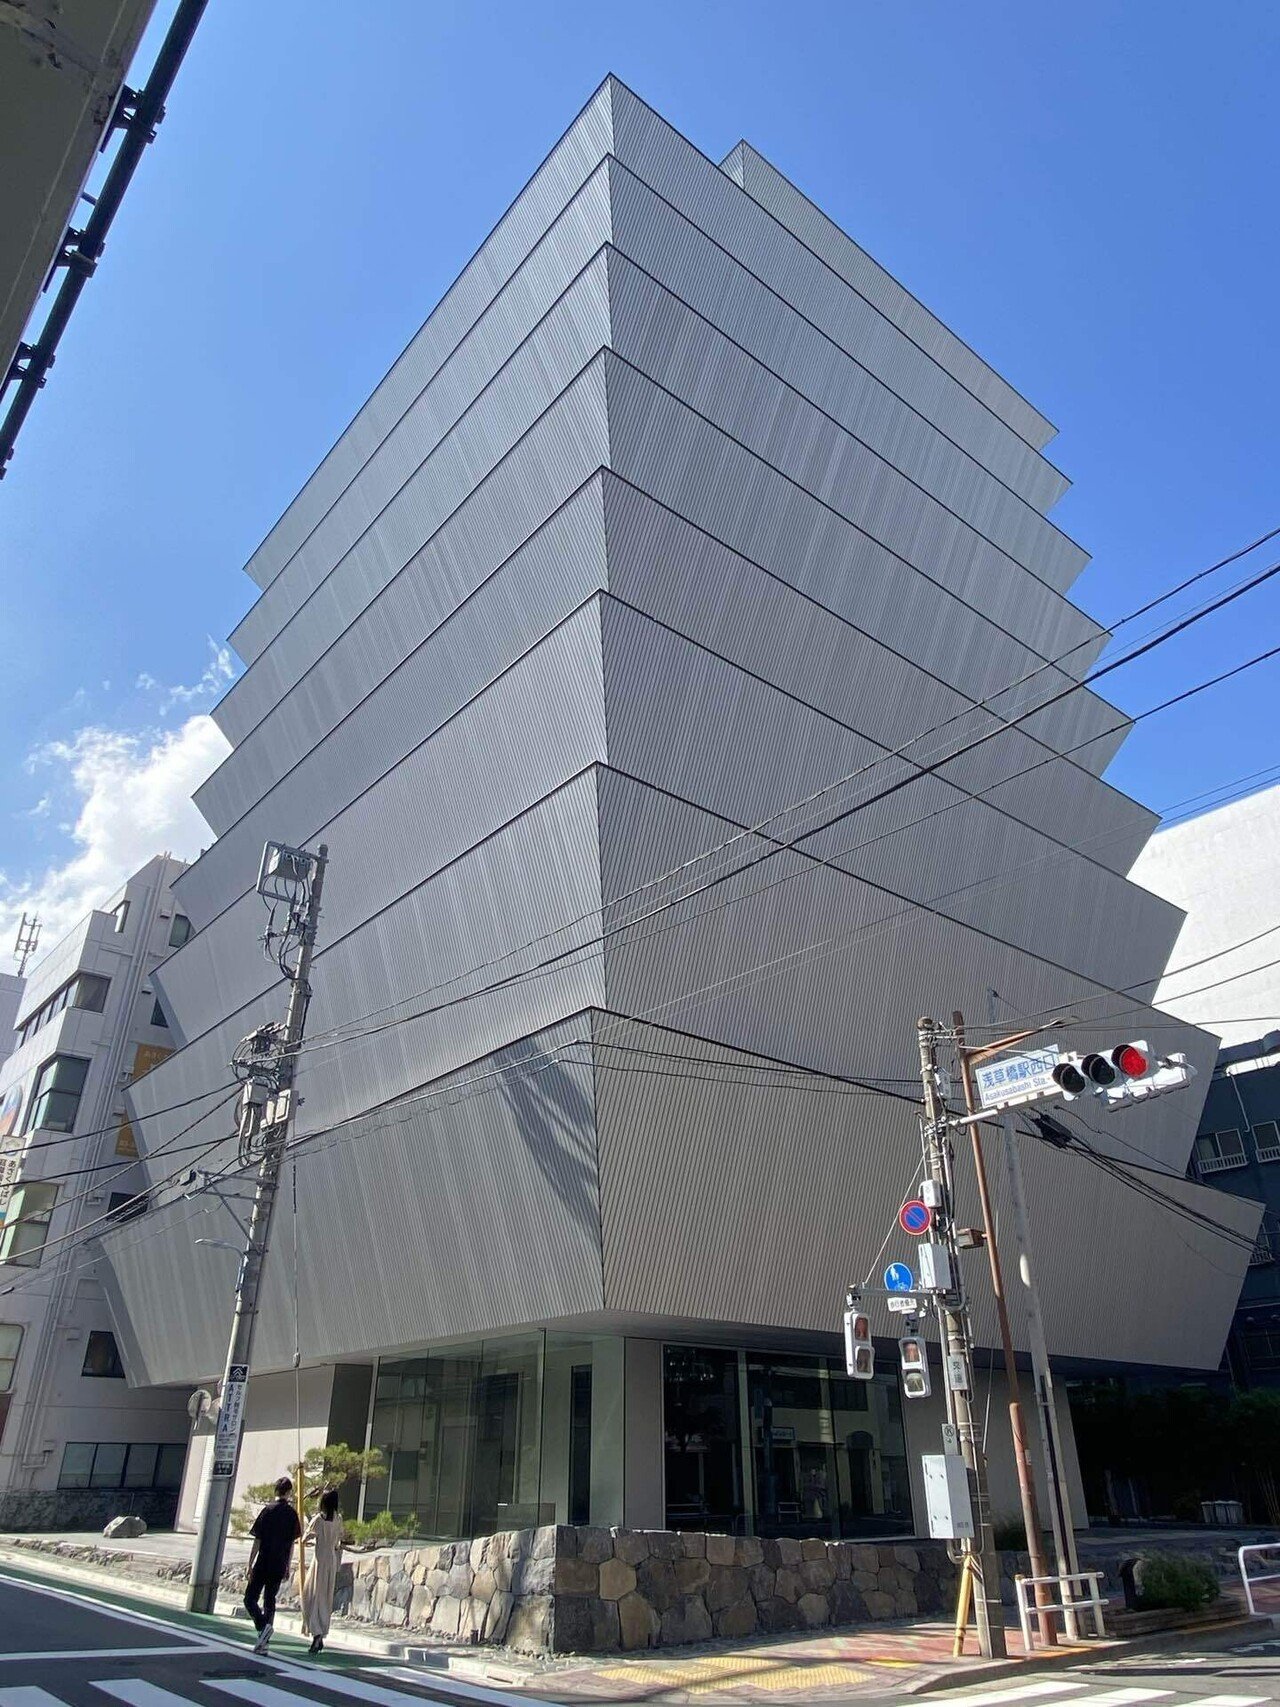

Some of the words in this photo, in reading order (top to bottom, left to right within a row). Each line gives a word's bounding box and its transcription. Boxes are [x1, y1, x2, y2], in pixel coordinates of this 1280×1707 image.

[982, 1054, 1056, 1089] 浅草橋駅西口
[985, 1081, 1031, 1102] Asakusabashi
[222, 1384, 234, 1432] ATTRA
